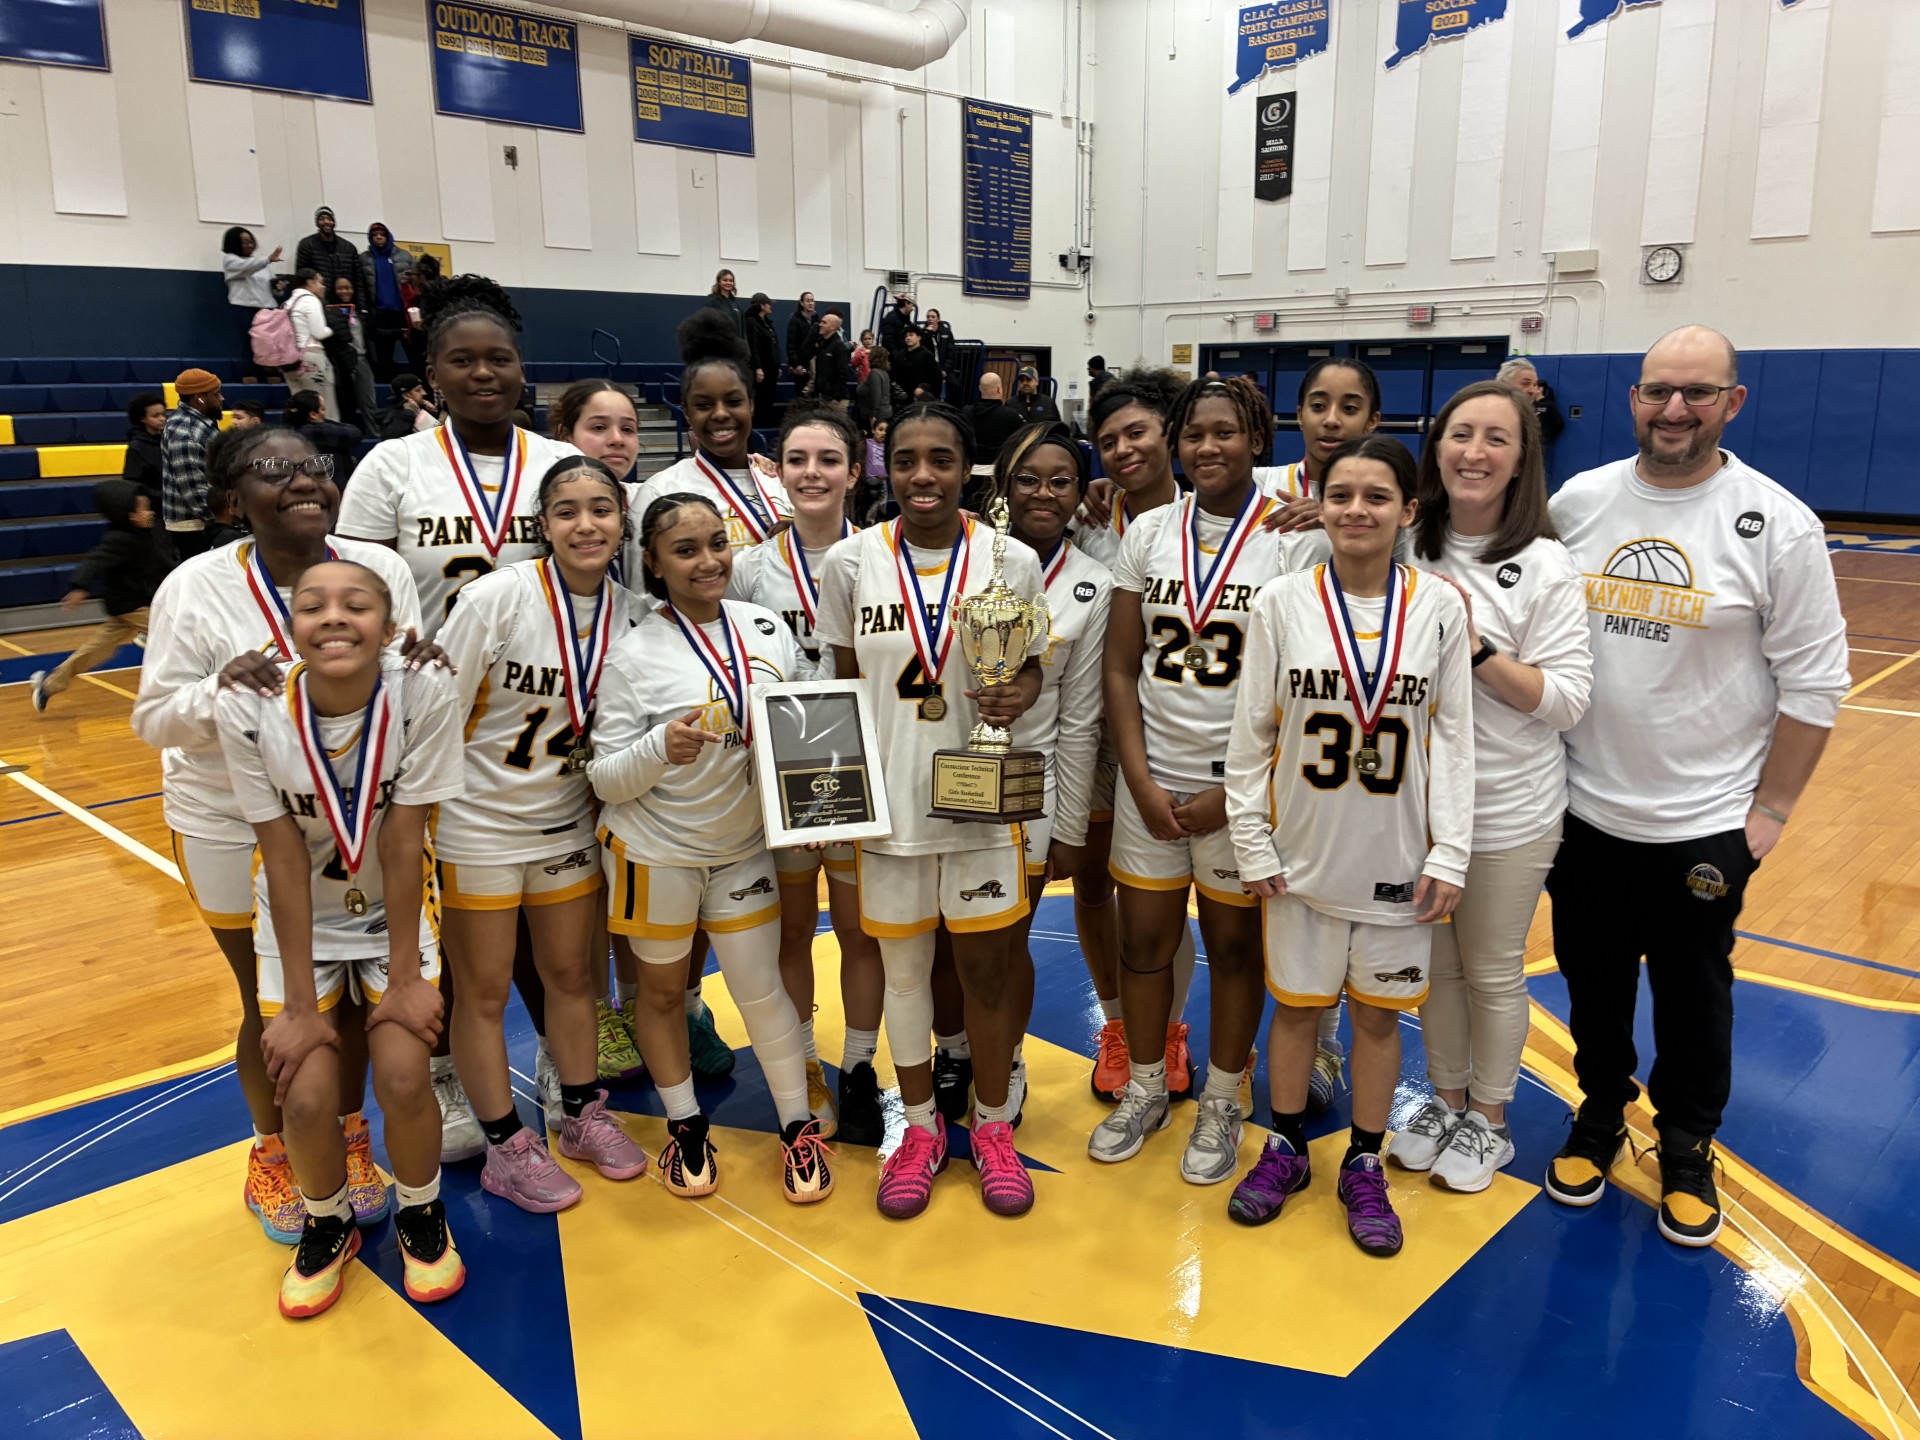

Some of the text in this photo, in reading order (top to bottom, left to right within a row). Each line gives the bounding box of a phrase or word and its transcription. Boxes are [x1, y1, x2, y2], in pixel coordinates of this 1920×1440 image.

[1277, 0, 1309, 16] CLASS
[1425, 0, 1477, 13] SOCCER
[435, 3, 571, 50] OUTDOOR TRACK
[1239, 10, 1328, 36] STATE CHAMPIONS
[1433, 13, 1465, 28] 2021
[1247, 25, 1317, 47] BASKETBALL
[440, 33, 545, 62] 1992 2015 2016 2025
[1268, 44, 1294, 58] 2018
[648, 44, 735, 80] SOFTBALL
[706, 80, 724, 93] 1987
[728, 85, 745, 98] 1991
[1737, 517, 1763, 533] RB
[1498, 568, 1520, 583] RB
[1075, 585, 1095, 597] RB
[1586, 579, 1706, 624] KAYNOR TECH
[756, 621, 774, 632] RB
[1603, 614, 1671, 643] PANTHERS
[1151, 613, 1246, 690] 23
[894, 650, 945, 722] 4
[504, 705, 597, 779] 14
[1300, 710, 1411, 797] 30
[970, 764, 995, 773] Technical
[810, 779, 841, 793] CTC
[812, 815, 848, 824] Champion
